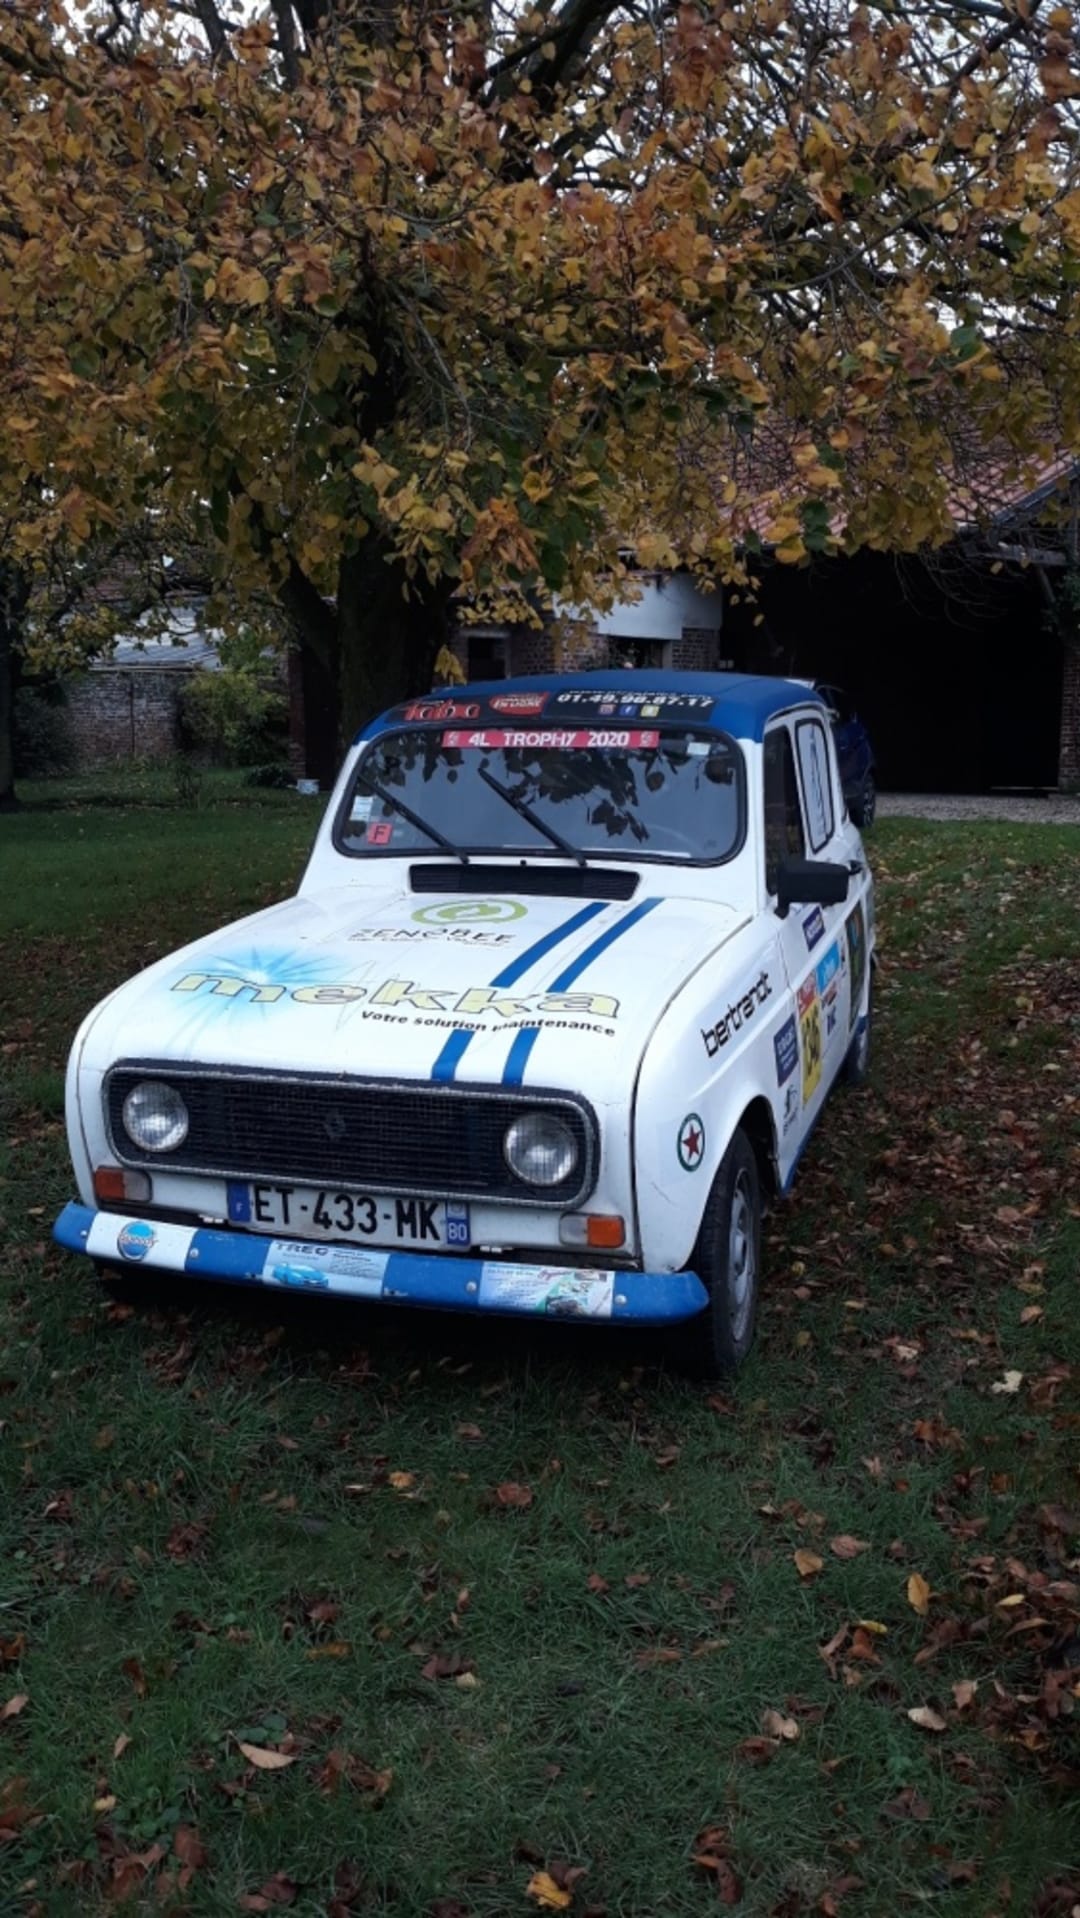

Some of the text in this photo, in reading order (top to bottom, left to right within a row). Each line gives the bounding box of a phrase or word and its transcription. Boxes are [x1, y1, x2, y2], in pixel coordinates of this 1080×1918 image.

[468, 731, 631, 747] 4L TROPHY 2020
[374, 825, 388, 840] F
[170, 972, 620, 1019] mekka
[361, 1010, 409, 1025] Votre
[413, 1016, 488, 1032] solution
[253, 1183, 442, 1242] ET-433-MK
[449, 1221, 468, 1242] 80
